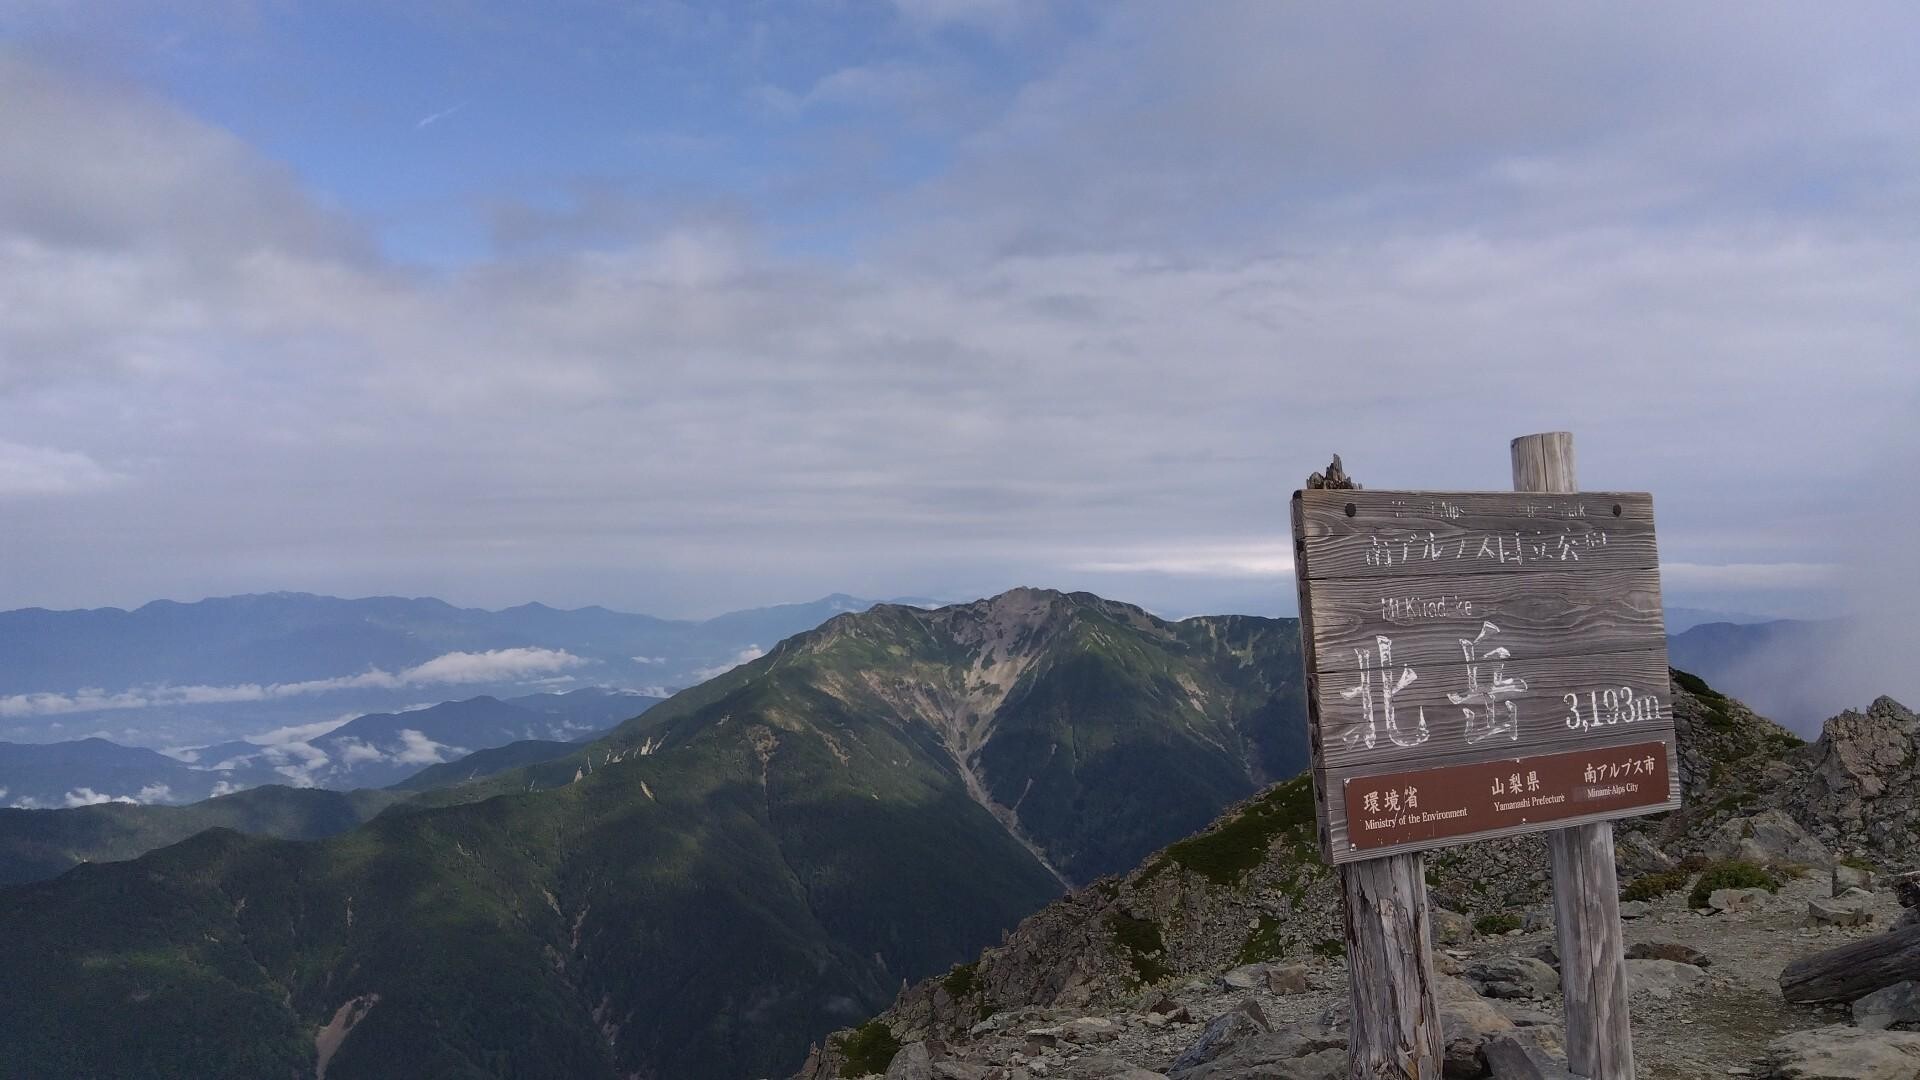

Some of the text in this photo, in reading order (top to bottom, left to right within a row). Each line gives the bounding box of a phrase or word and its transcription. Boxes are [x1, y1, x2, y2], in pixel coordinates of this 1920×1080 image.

[1405, 596, 1472, 618] Kitadke
[1563, 686, 1662, 733] 3,193m
[1584, 756, 1655, 783] 南アルプス市
[1491, 771, 1540, 795] 山梨県
[1626, 783, 1639, 793] City
[1363, 786, 1418, 814] 環境省
[1494, 793, 1565, 811] Yamanashi Prefecture
[1364, 807, 1468, 830] Ministry of the Environment
